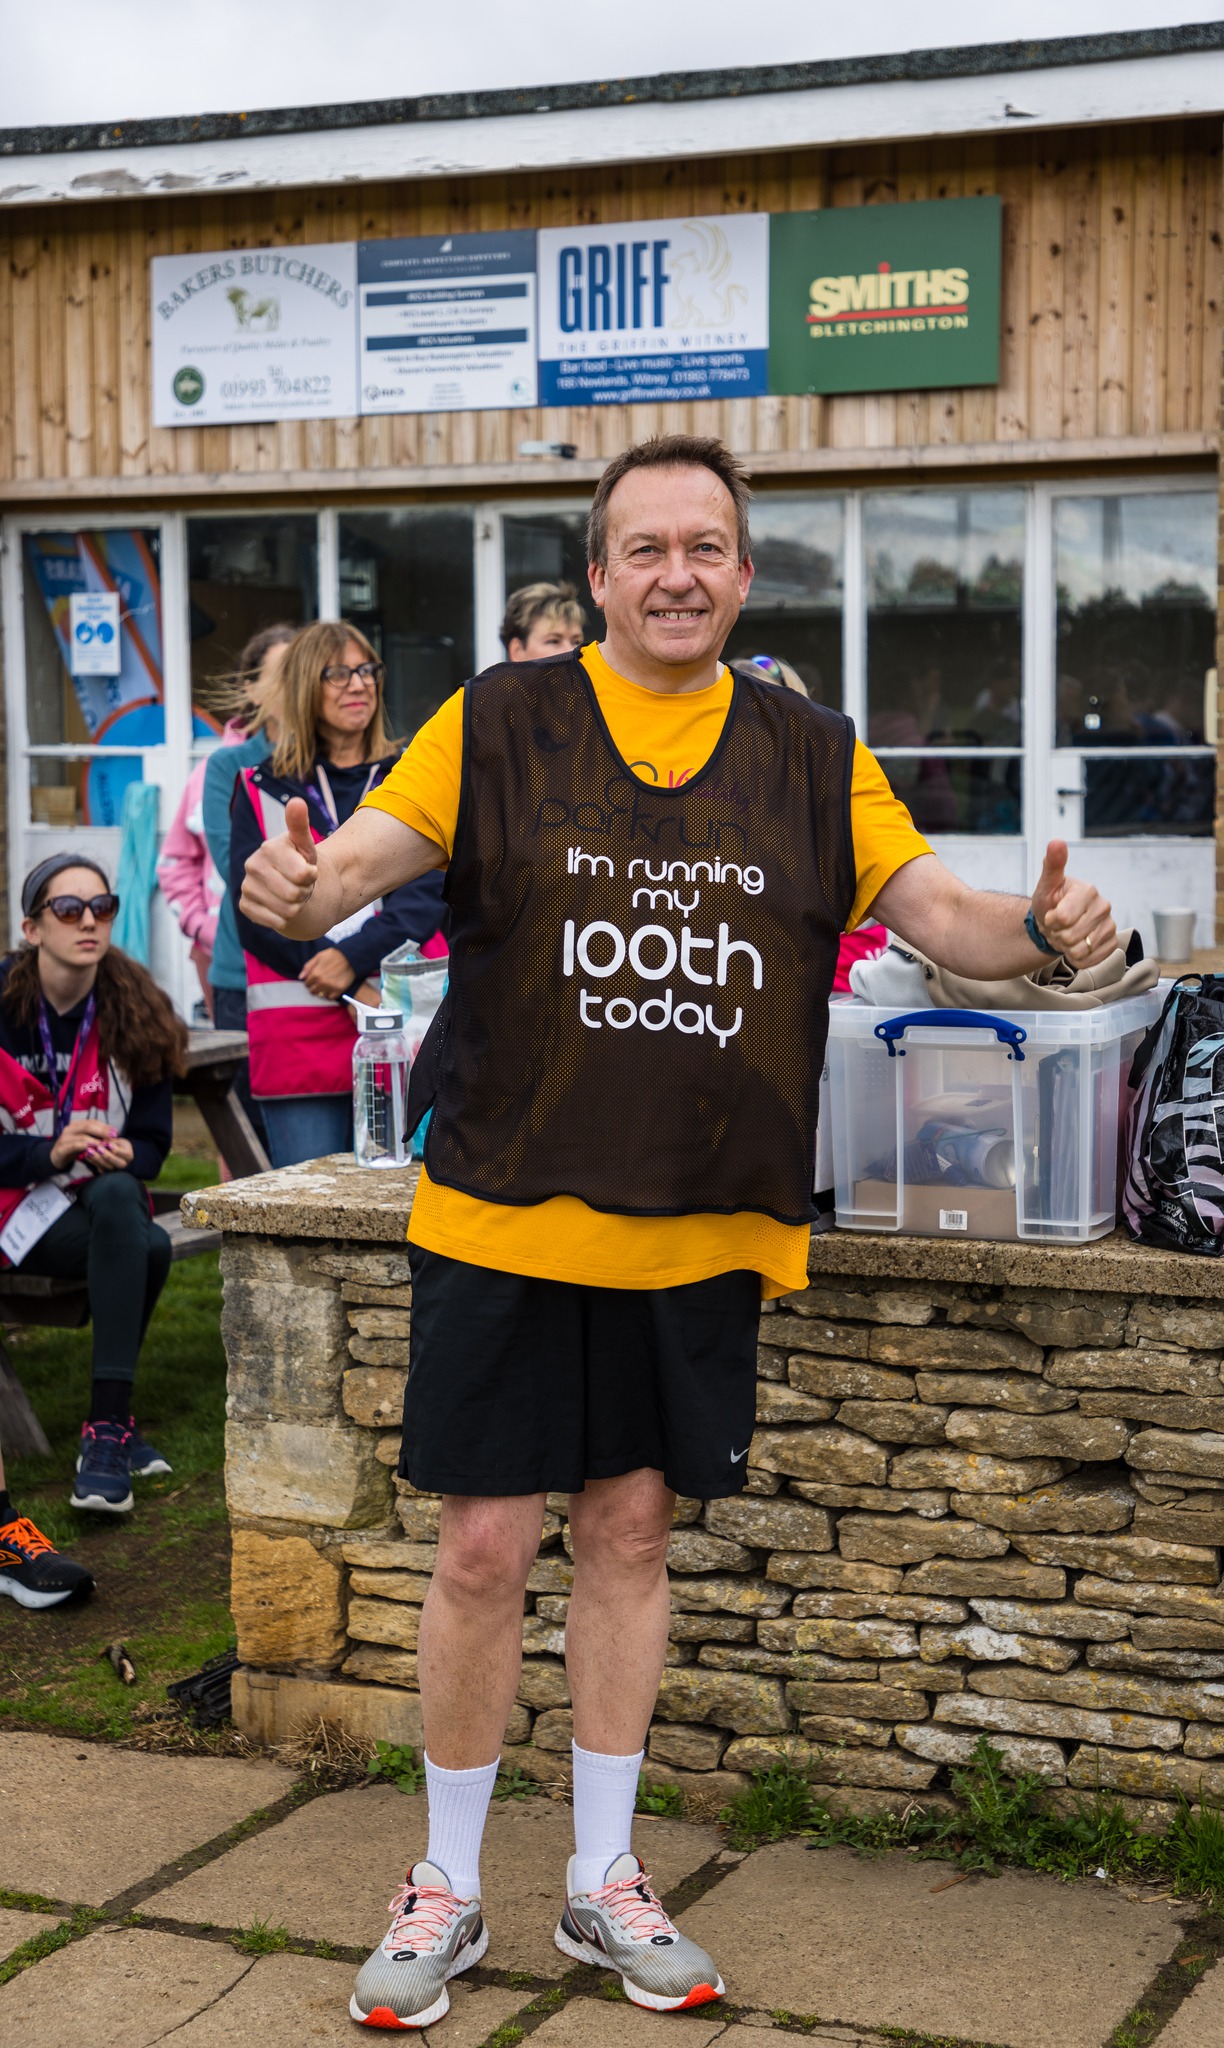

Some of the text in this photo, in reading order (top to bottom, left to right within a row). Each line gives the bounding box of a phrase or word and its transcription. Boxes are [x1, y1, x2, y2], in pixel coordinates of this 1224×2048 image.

[157, 254, 352, 320] BAKERS BUTCHERS
[559, 239, 671, 334] GRIFF
[808, 261, 969, 318] SMITHS
[558, 332, 749, 353] THE GRIFFIN WITNEY
[810, 315, 968, 338] BLETCHINGTON
[560, 361, 581, 374] Bar
[582, 359, 607, 373] food
[615, 358, 640, 371] Live
[642, 357, 674, 370] music
[682, 355, 706, 368] Live
[709, 353, 745, 368] sports
[567, 846, 765, 895] I'm running
[632, 887, 700, 919] my
[563, 919, 763, 990] 100th
[580, 988, 743, 1049] today
